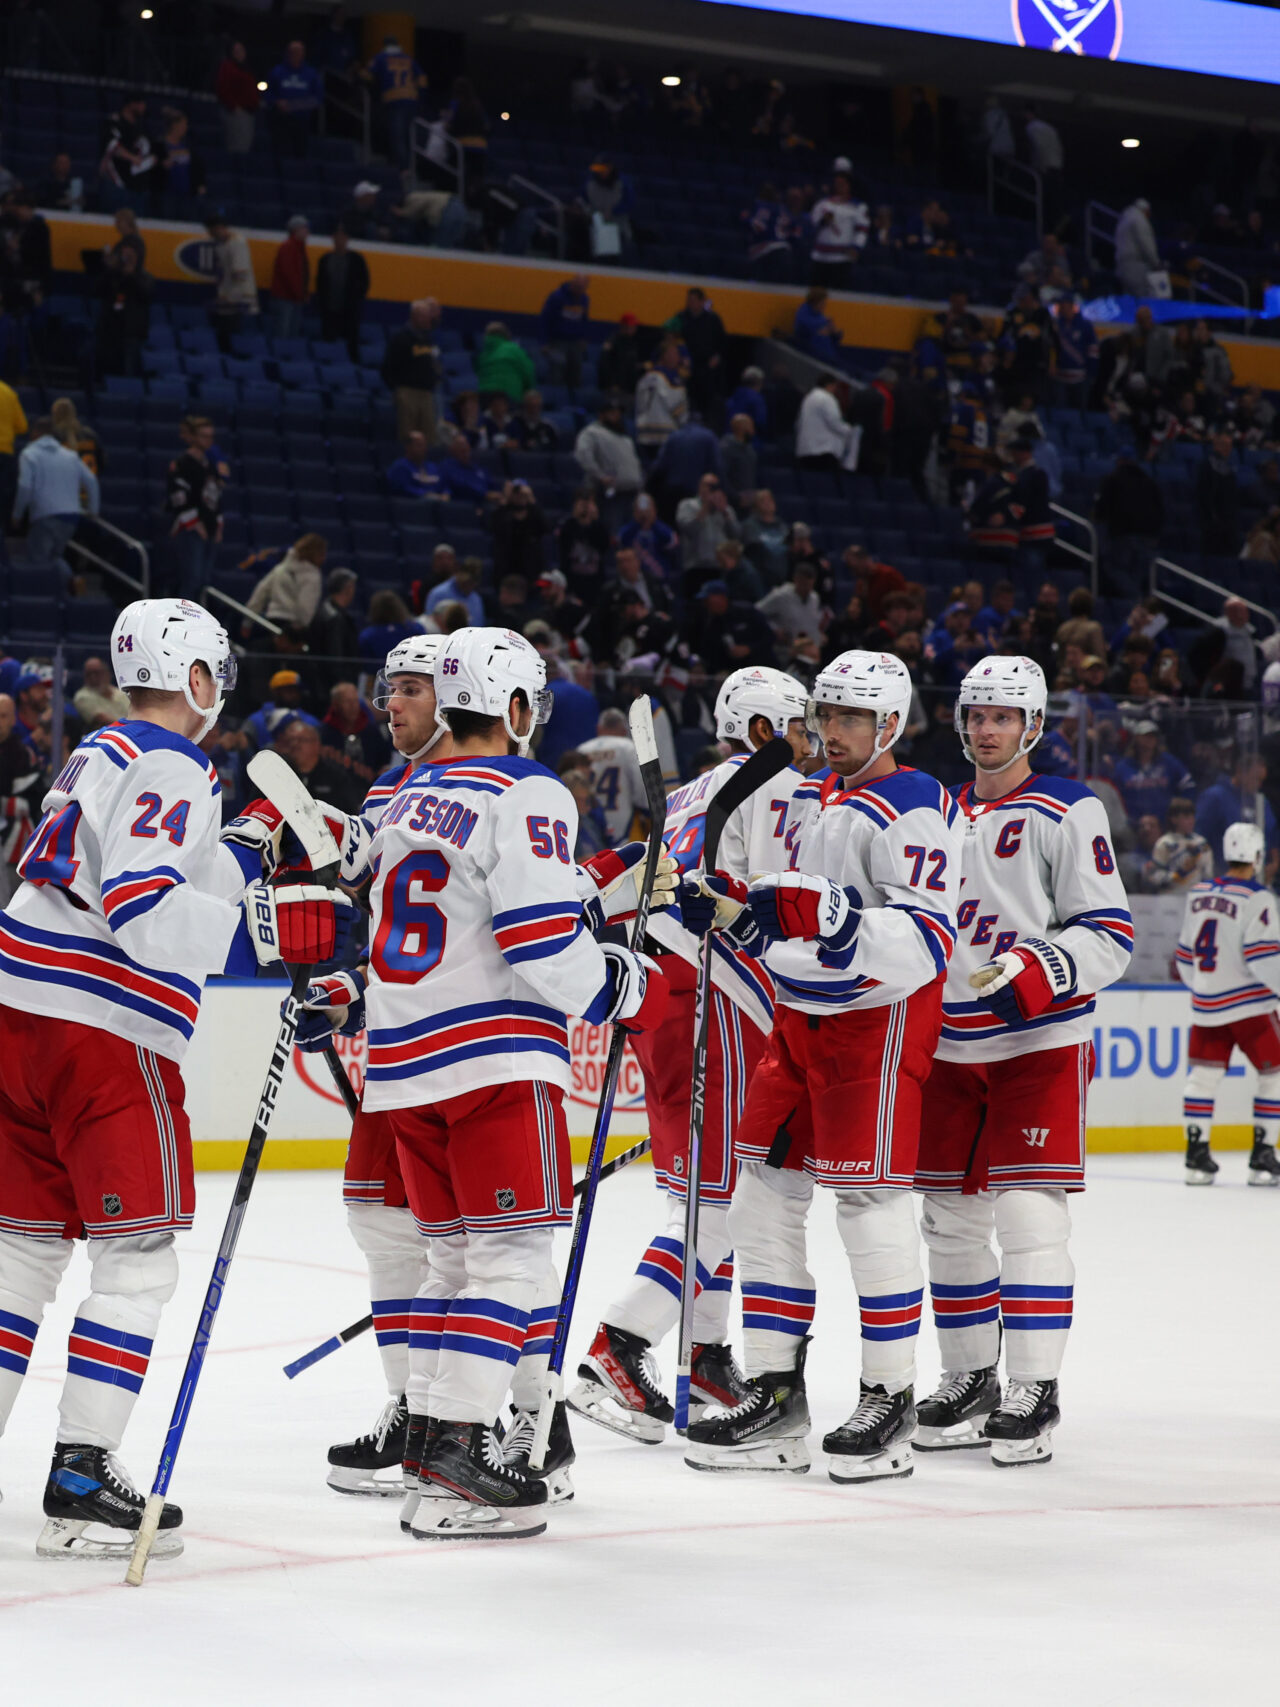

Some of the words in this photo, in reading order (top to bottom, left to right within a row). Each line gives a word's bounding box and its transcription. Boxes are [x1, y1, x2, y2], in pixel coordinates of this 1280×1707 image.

[117, 634, 133, 653] 24
[389, 649, 408, 658] CCM
[442, 658, 460, 675] 56
[131, 791, 192, 847] 24
[994, 818, 1026, 859] C
[526, 815, 571, 865] 56
[1092, 835, 1115, 875] 8
[904, 845, 947, 892] 72
[1258, 907, 1270, 926] 4
[1194, 919, 1218, 973] 4
[255, 995, 303, 1133] BAUER
[816, 1159, 872, 1171] BAUER
[597, 1350, 645, 1412] CCM
[737, 1417, 771, 1440] BAUER
[99, 1493, 133, 1513] BAUER
